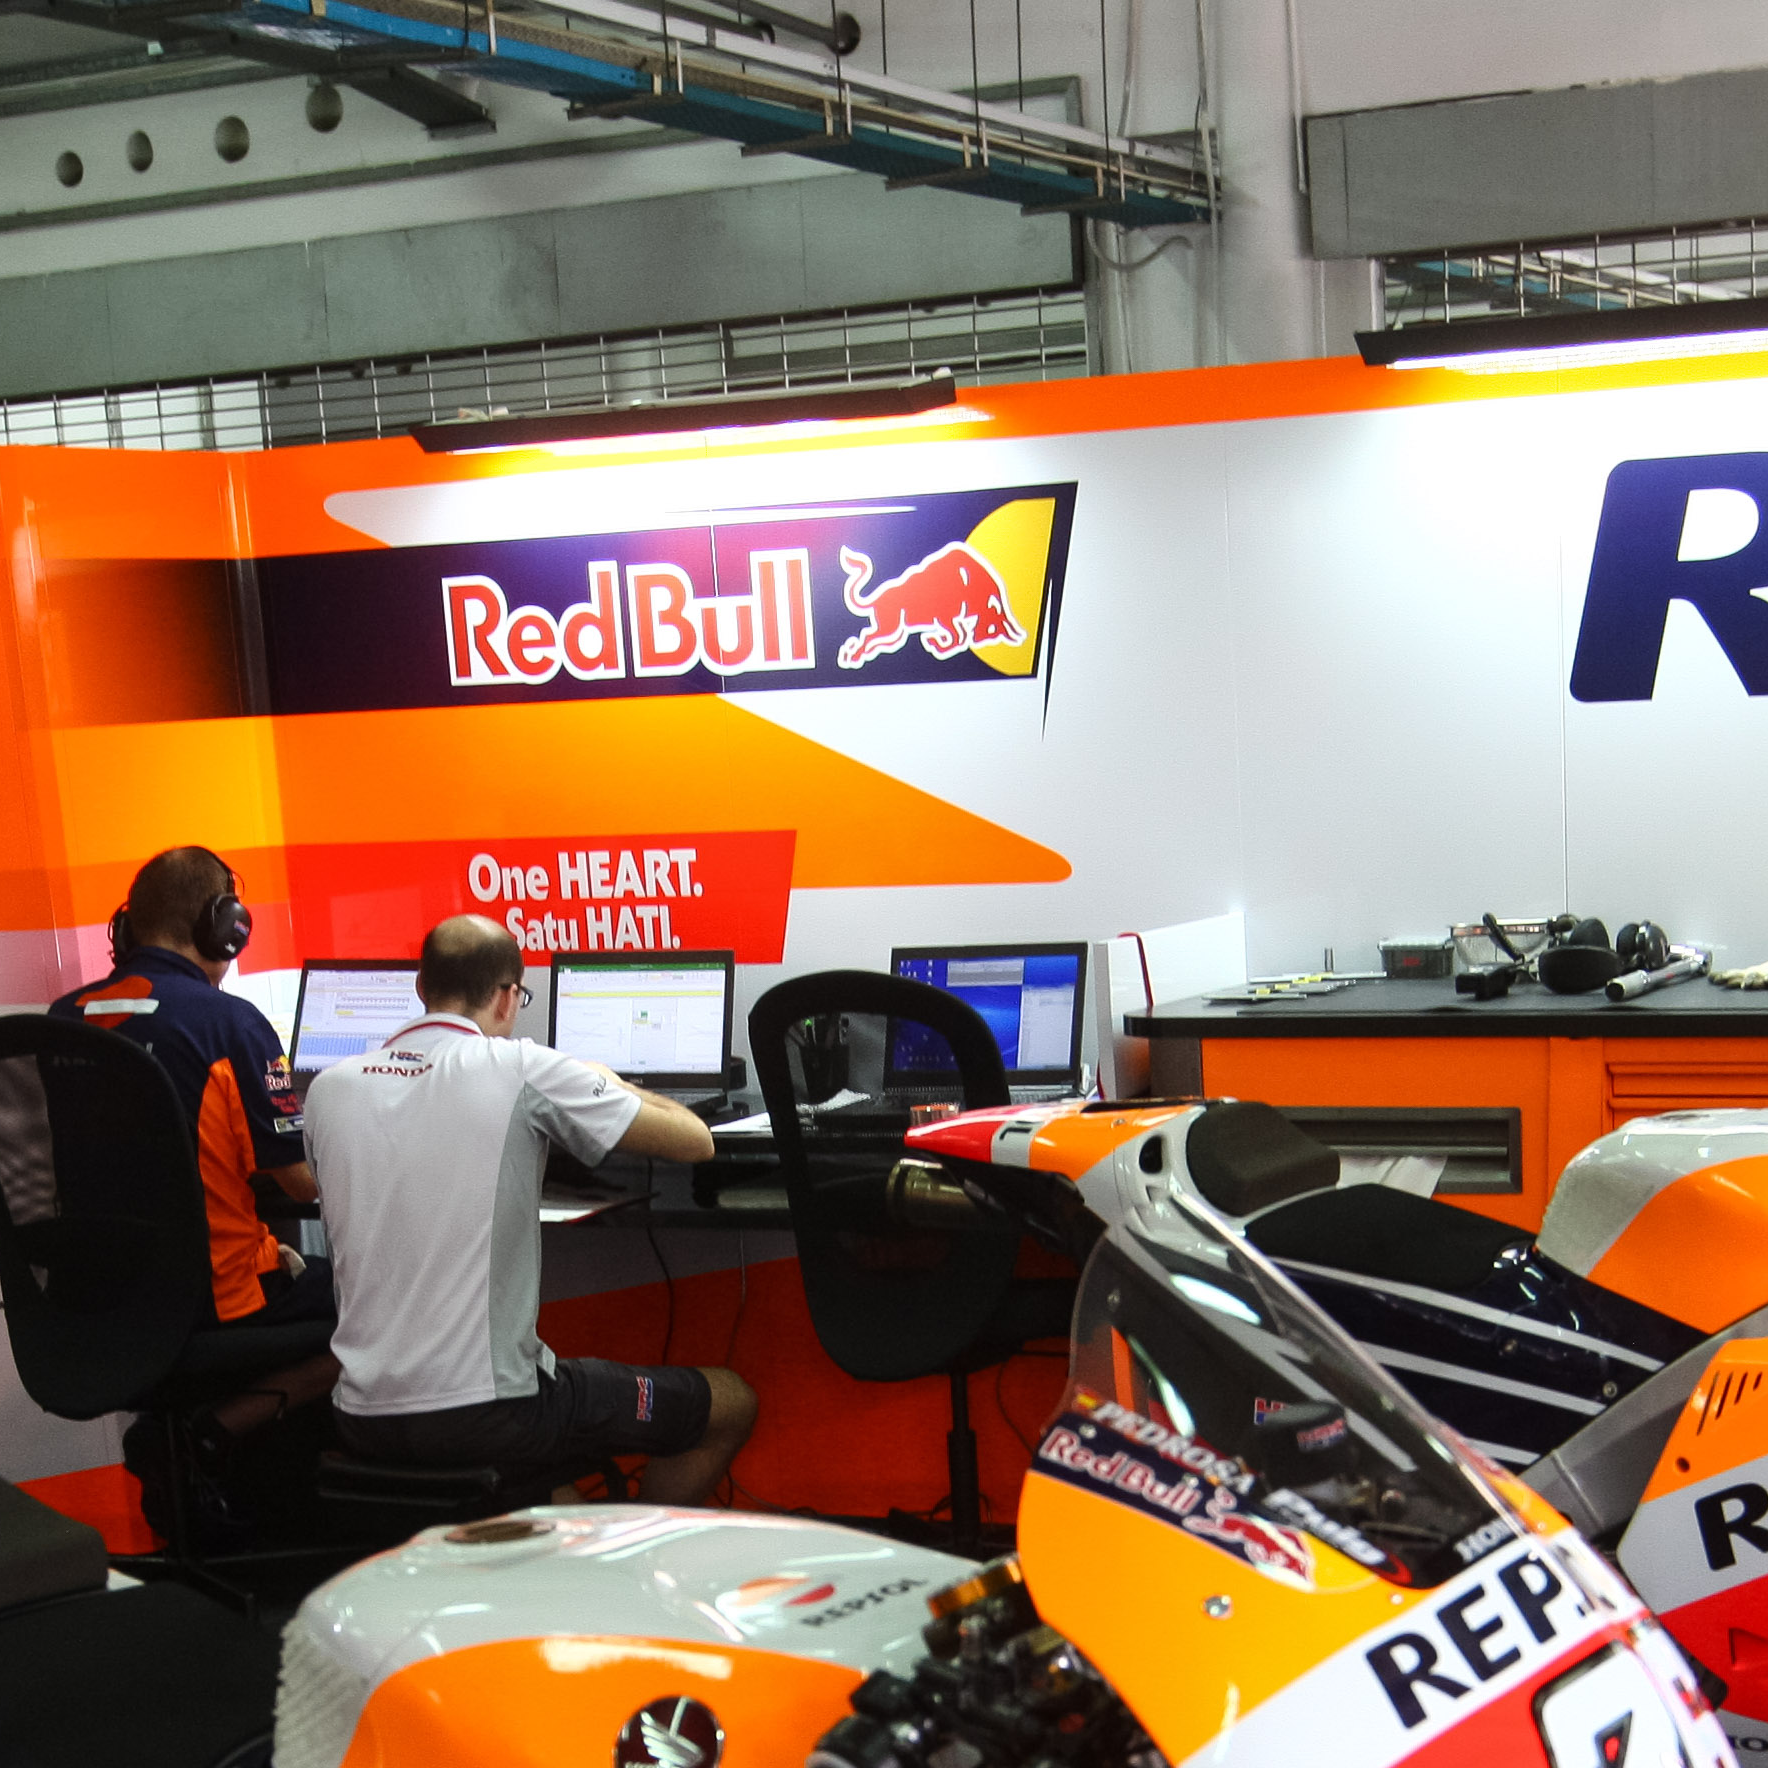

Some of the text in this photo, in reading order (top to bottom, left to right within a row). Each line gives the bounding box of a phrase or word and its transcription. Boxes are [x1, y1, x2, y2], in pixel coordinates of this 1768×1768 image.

[442, 548, 817, 687] Red Bull
[468, 848, 703, 903] One HEART.
[505, 905, 682, 952] Satu HATI.
[1092, 1400, 1256, 1495] PEDROSA
